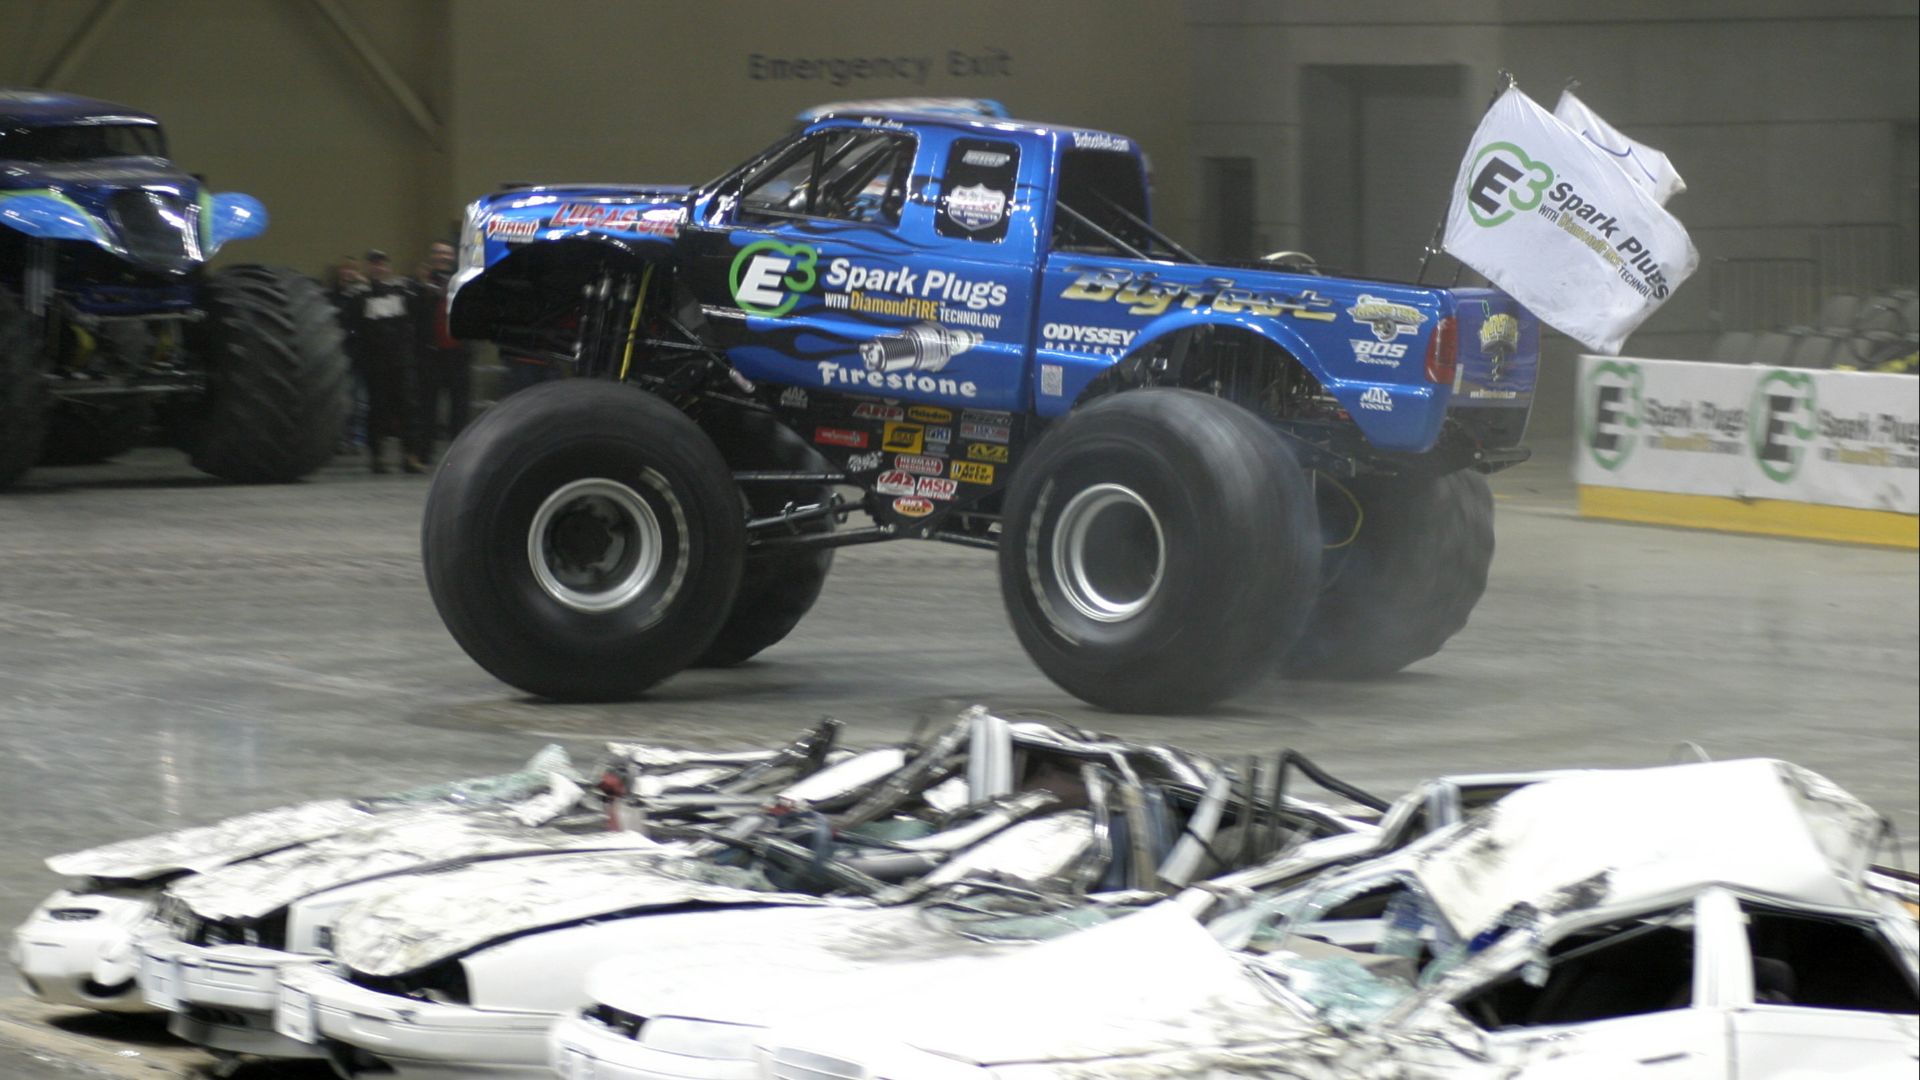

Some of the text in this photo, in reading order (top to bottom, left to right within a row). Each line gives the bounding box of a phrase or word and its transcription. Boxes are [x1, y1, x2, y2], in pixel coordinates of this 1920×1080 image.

[748, 47, 1013, 87] Emergency Exit
[1468, 149, 1555, 221] E3
[549, 203, 638, 231] LUCAS
[1538, 204, 1559, 223] WITH
[1548, 182, 1669, 300] Spark Plugs
[731, 242, 818, 311] E3
[826, 258, 1008, 309] Spark Plugs
[825, 292, 1001, 329] WITH DiamondFIRE TECHNOLOGY
[1043, 323, 1136, 346] ODYSSEY
[1045, 341, 1128, 357] BATTERY
[1356, 354, 1400, 368] Racing
[817, 361, 977, 397] Firestone
[1360, 387, 1392, 405] MAC
[1360, 402, 1392, 411] TOOLS
[920, 479, 954, 492] MSD
